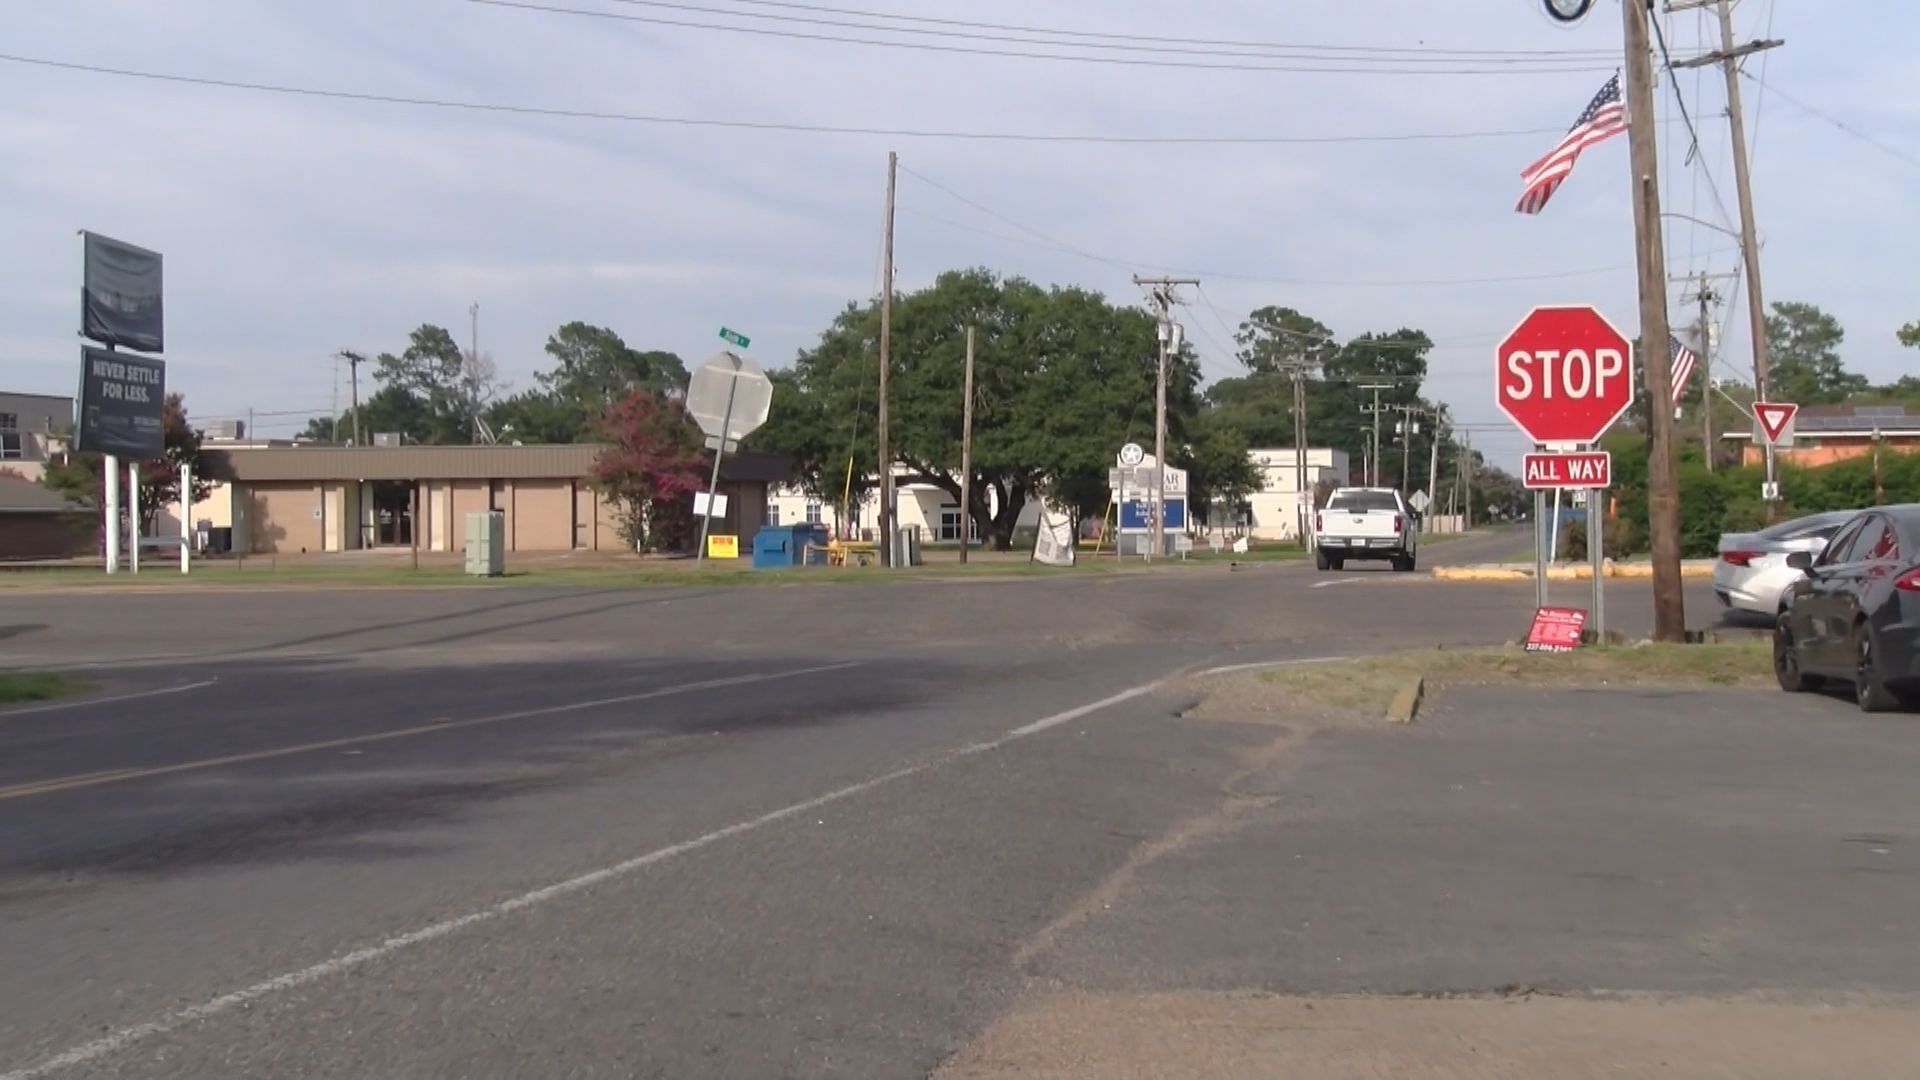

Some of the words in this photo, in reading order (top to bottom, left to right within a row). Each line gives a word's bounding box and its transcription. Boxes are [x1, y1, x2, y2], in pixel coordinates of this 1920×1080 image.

[93, 360, 125, 379] NEVER
[128, 365, 160, 384] SETTLE
[1506, 349, 1622, 400] STOP
[103, 381, 123, 399] FOR
[125, 385, 150, 402] LESS.
[1528, 461, 1560, 480] ALL
[1567, 459, 1605, 479] WAY
